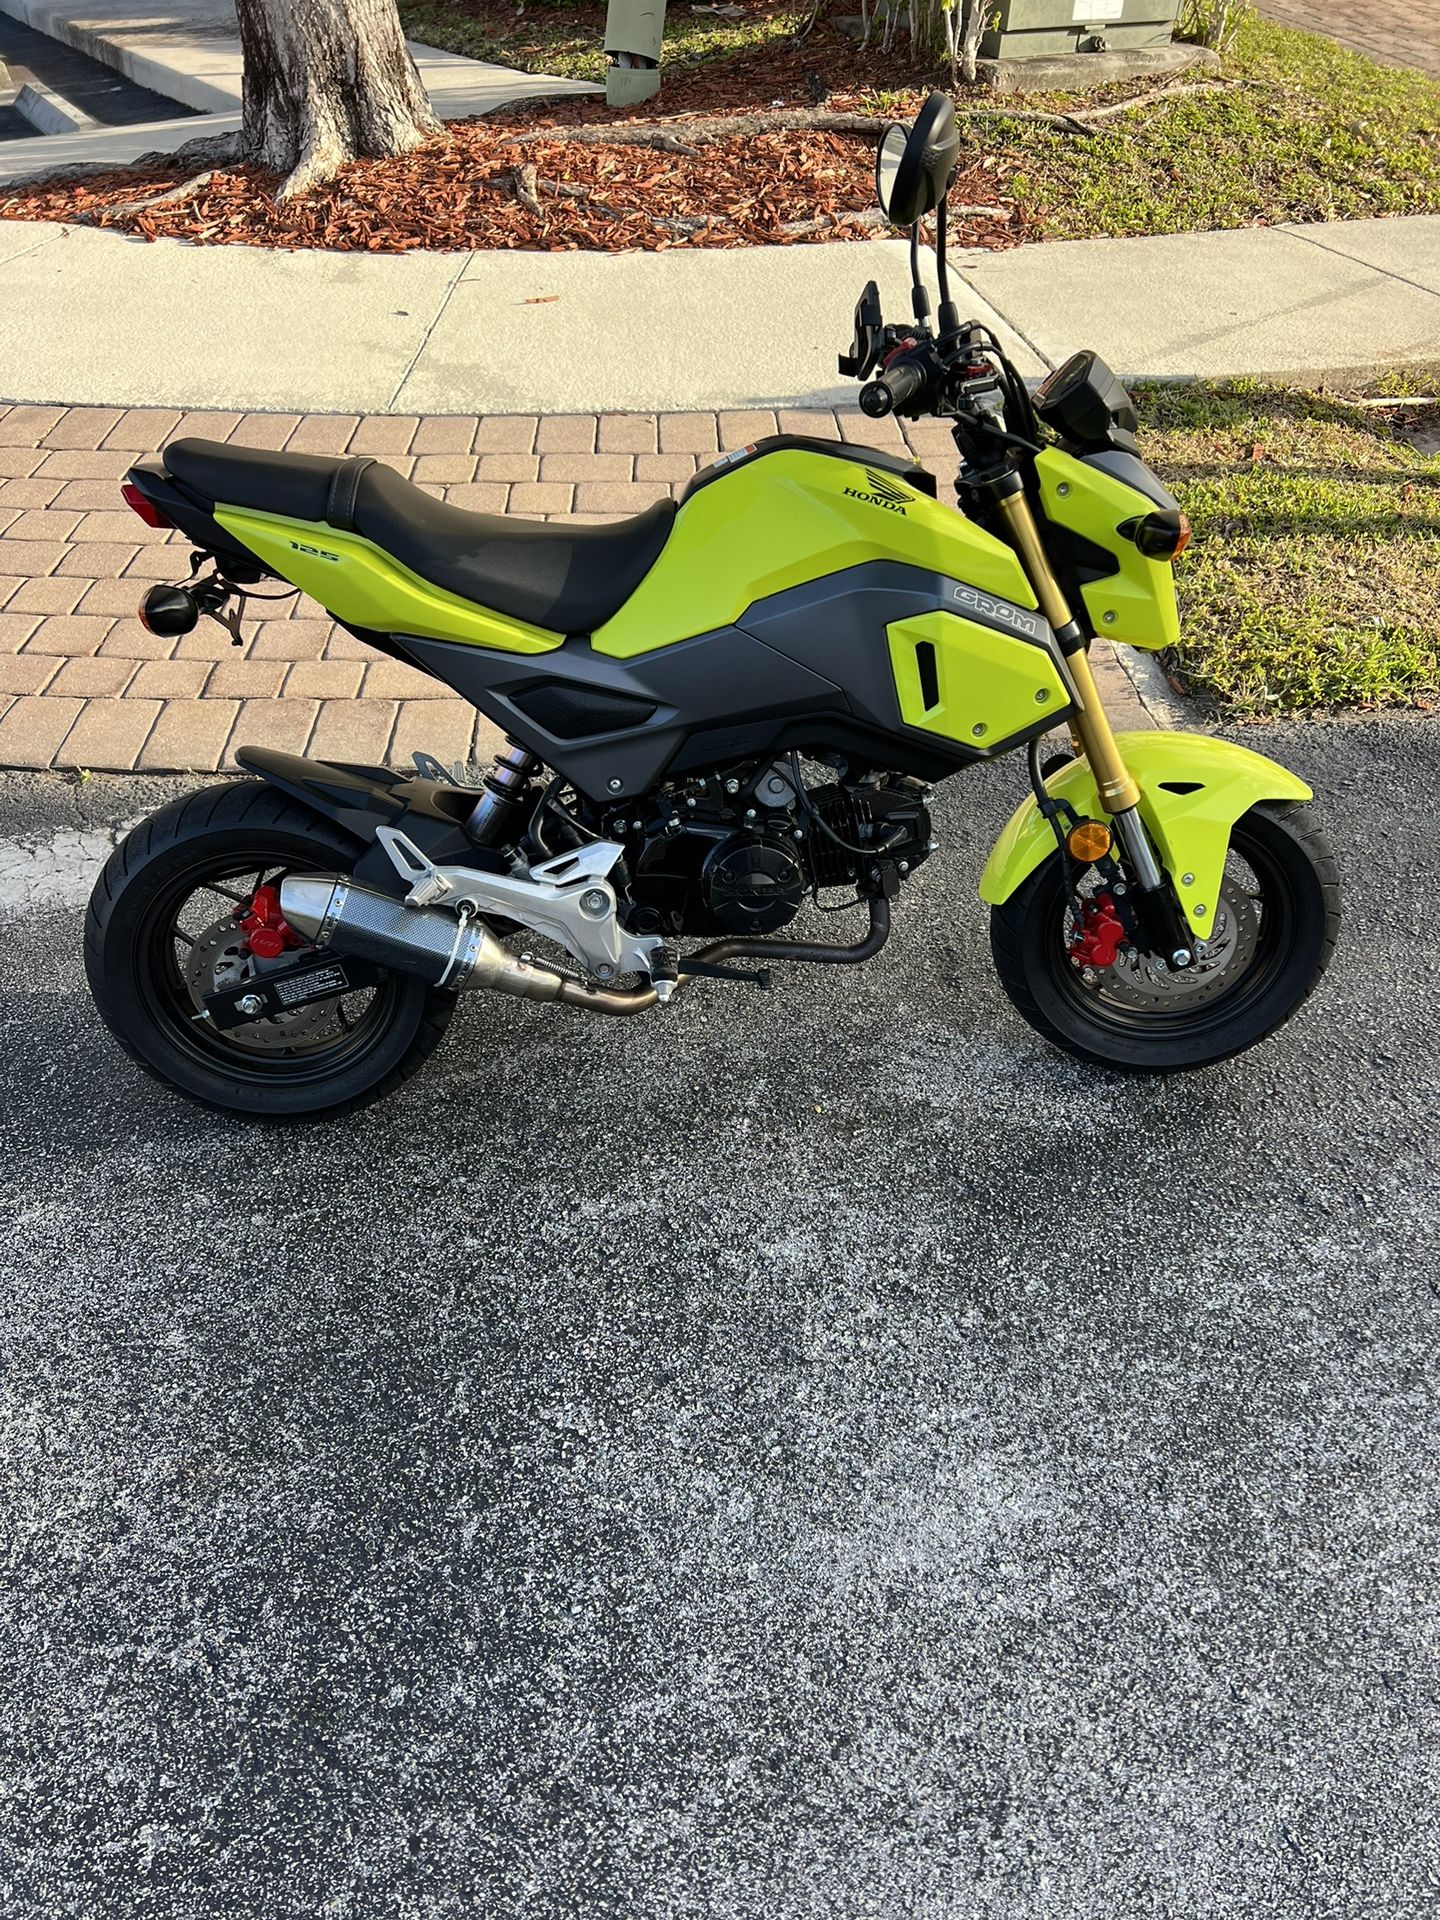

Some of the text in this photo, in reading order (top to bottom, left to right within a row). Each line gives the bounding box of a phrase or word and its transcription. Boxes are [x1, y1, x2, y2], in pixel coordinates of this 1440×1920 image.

[842, 487, 907, 516] HONDA
[289, 540, 340, 562] 125
[953, 586, 1037, 635] GROM
